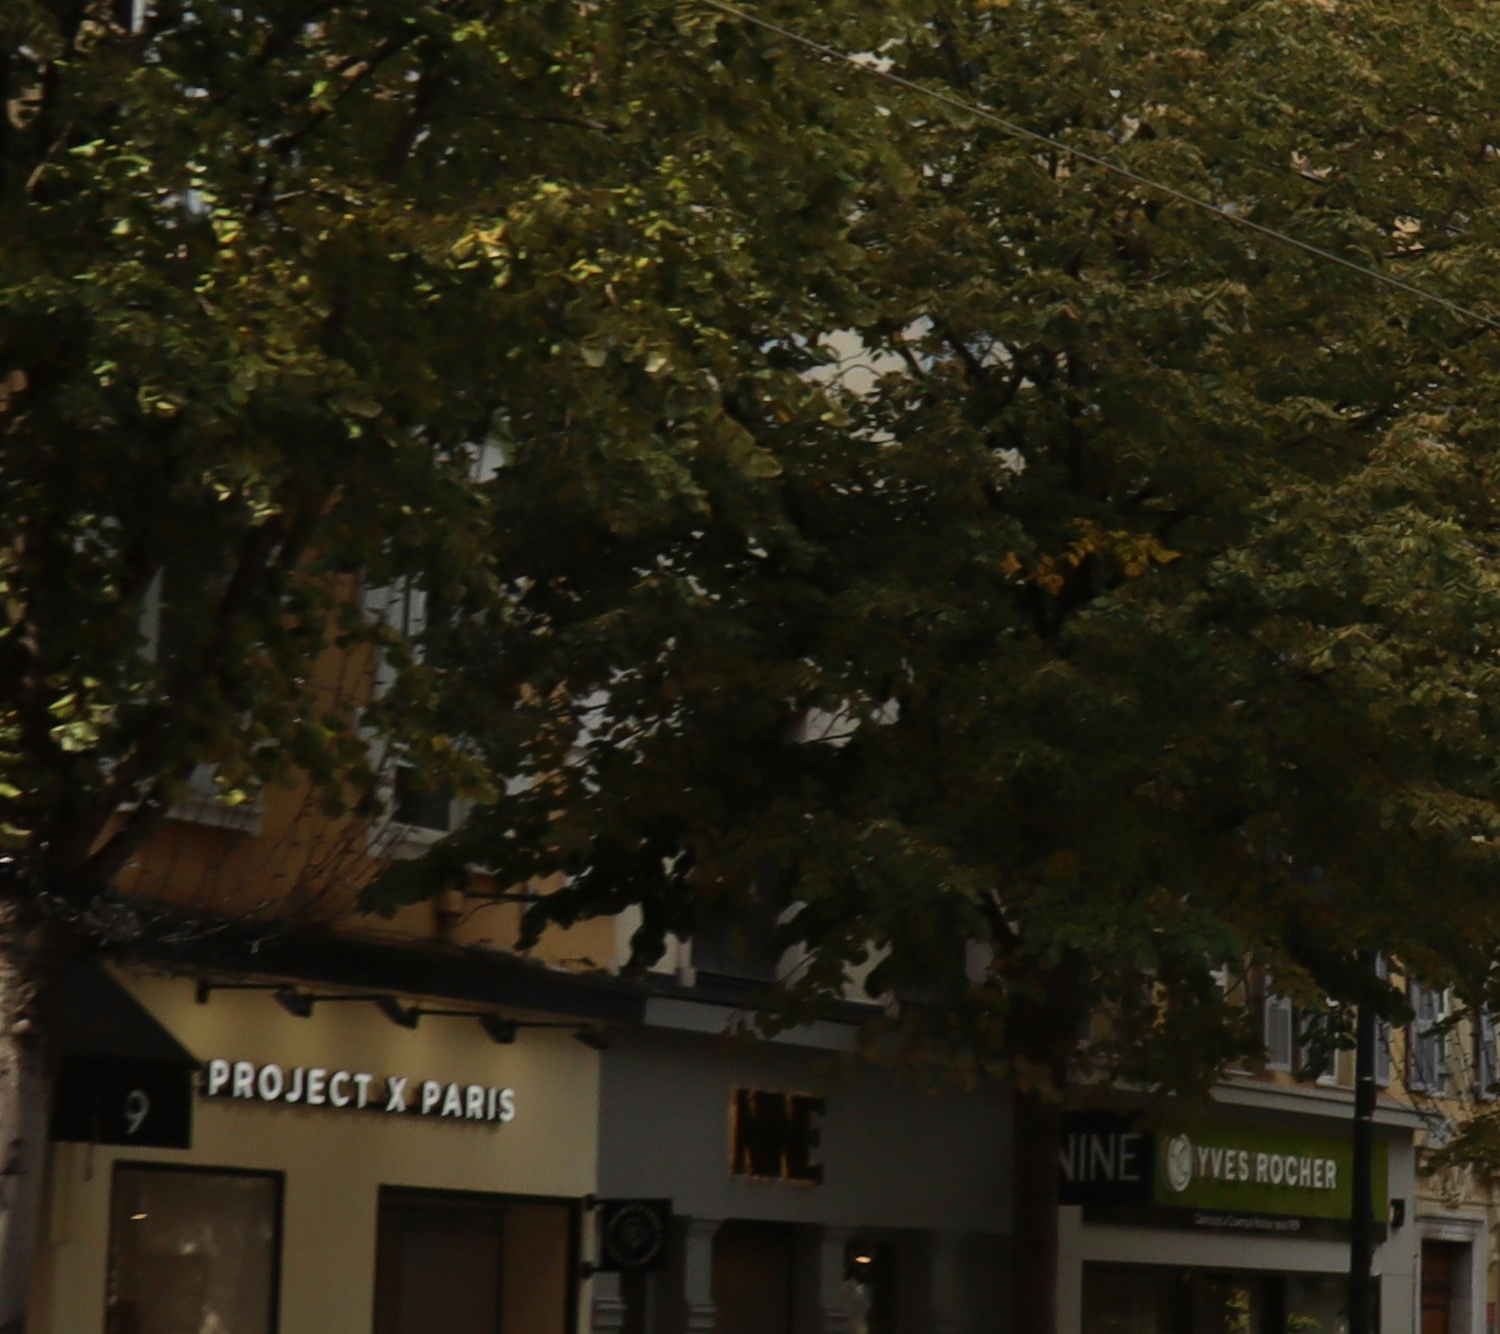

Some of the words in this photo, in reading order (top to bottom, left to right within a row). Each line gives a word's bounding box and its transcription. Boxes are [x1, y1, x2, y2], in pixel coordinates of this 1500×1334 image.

[124, 1089, 150, 1135] 9
[208, 1059, 373, 1108] PROJECT
[386, 1075, 408, 1112] X
[421, 1080, 516, 1122] PARIS
[1195, 1145, 1250, 1181] YVES
[1256, 1152, 1338, 1189] ROCHER
